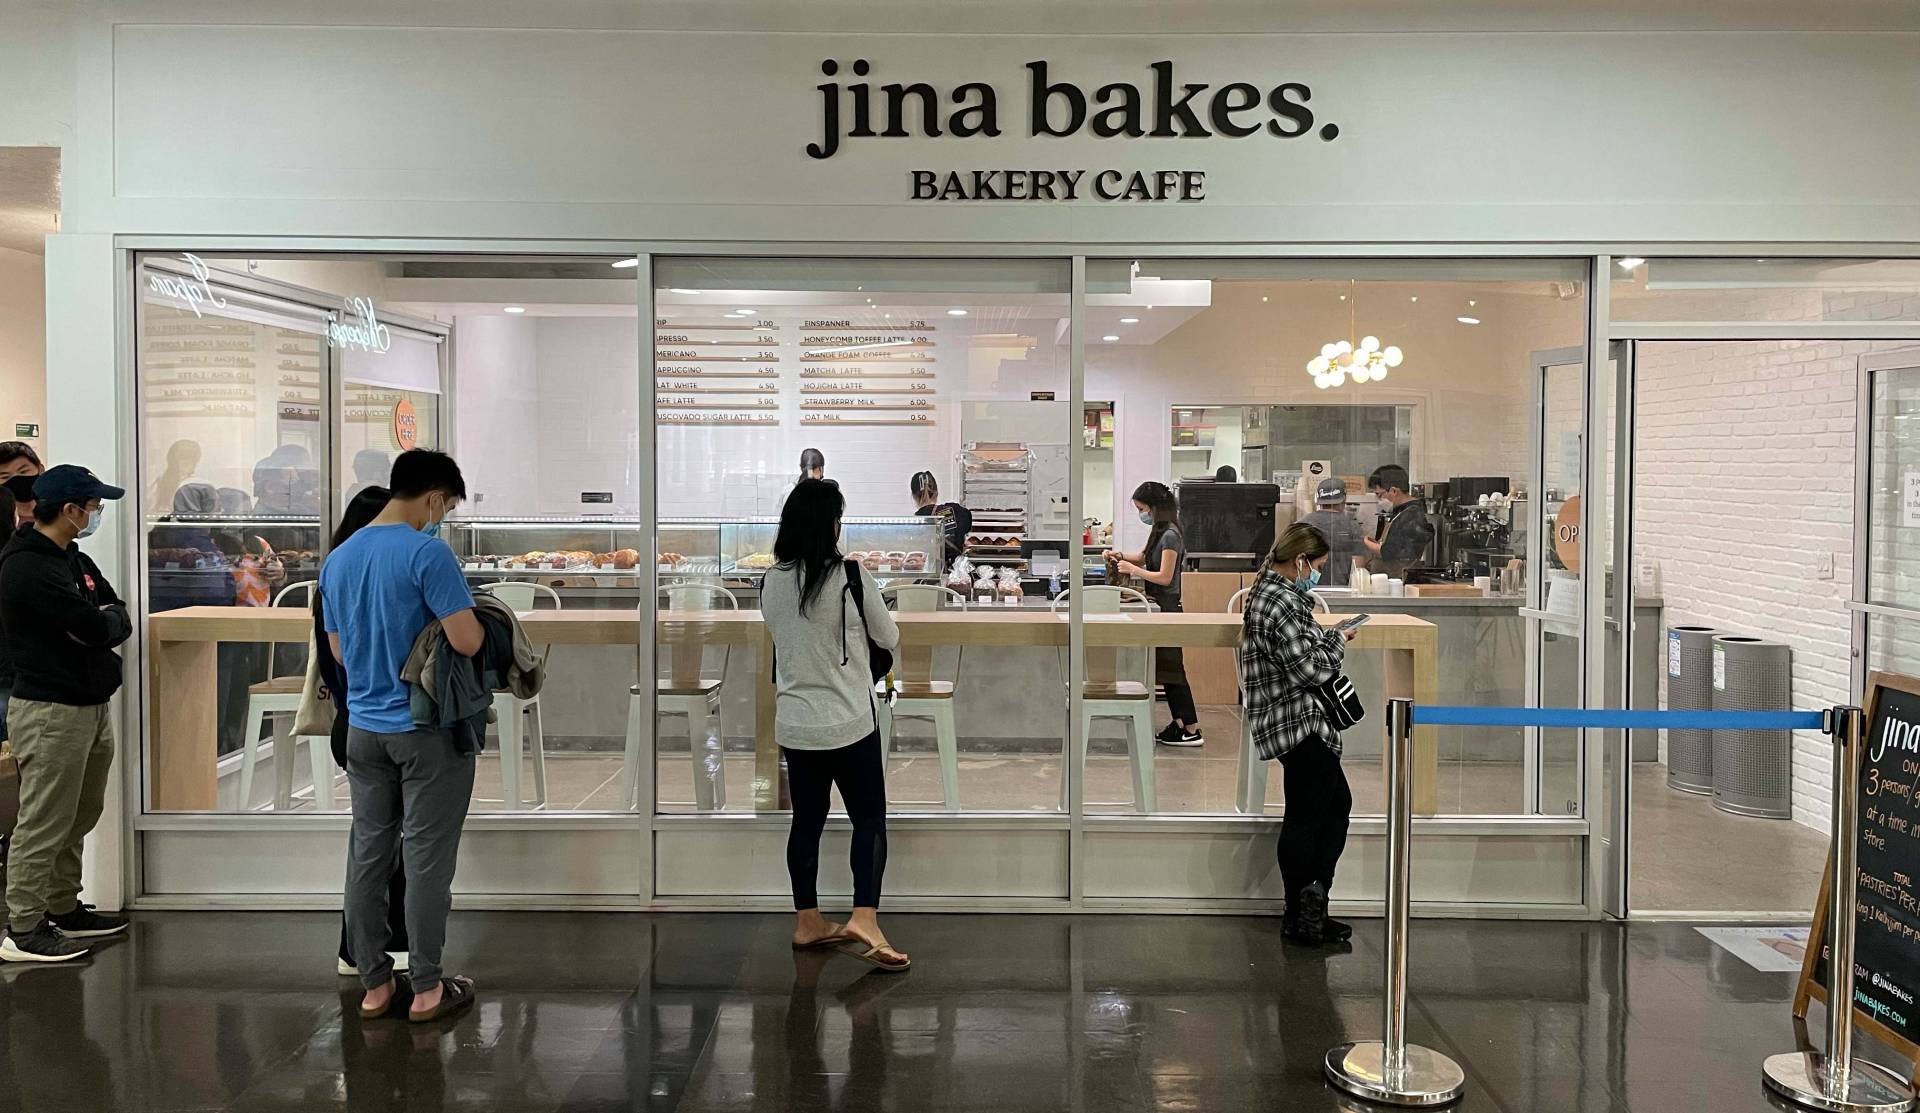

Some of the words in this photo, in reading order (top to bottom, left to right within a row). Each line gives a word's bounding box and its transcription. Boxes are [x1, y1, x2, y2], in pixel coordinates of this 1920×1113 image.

[806, 58, 1002, 159] jina
[1026, 60, 1340, 141] bakes.
[910, 170, 1086, 200] BAKERY
[1095, 169, 1206, 202] CAFE
[1559, 524, 1580, 543] OP
[1870, 705, 1920, 763] jina
[1866, 768, 1879, 795] 3
[1866, 804, 1878, 821] at
[1879, 813, 1885, 827] a
[1888, 811, 1907, 833] time
[1864, 829, 1886, 852] store.
[1894, 872, 1912, 887] TOTAL
[1898, 890, 1916, 912] PER
[1902, 925, 1914, 938] per
